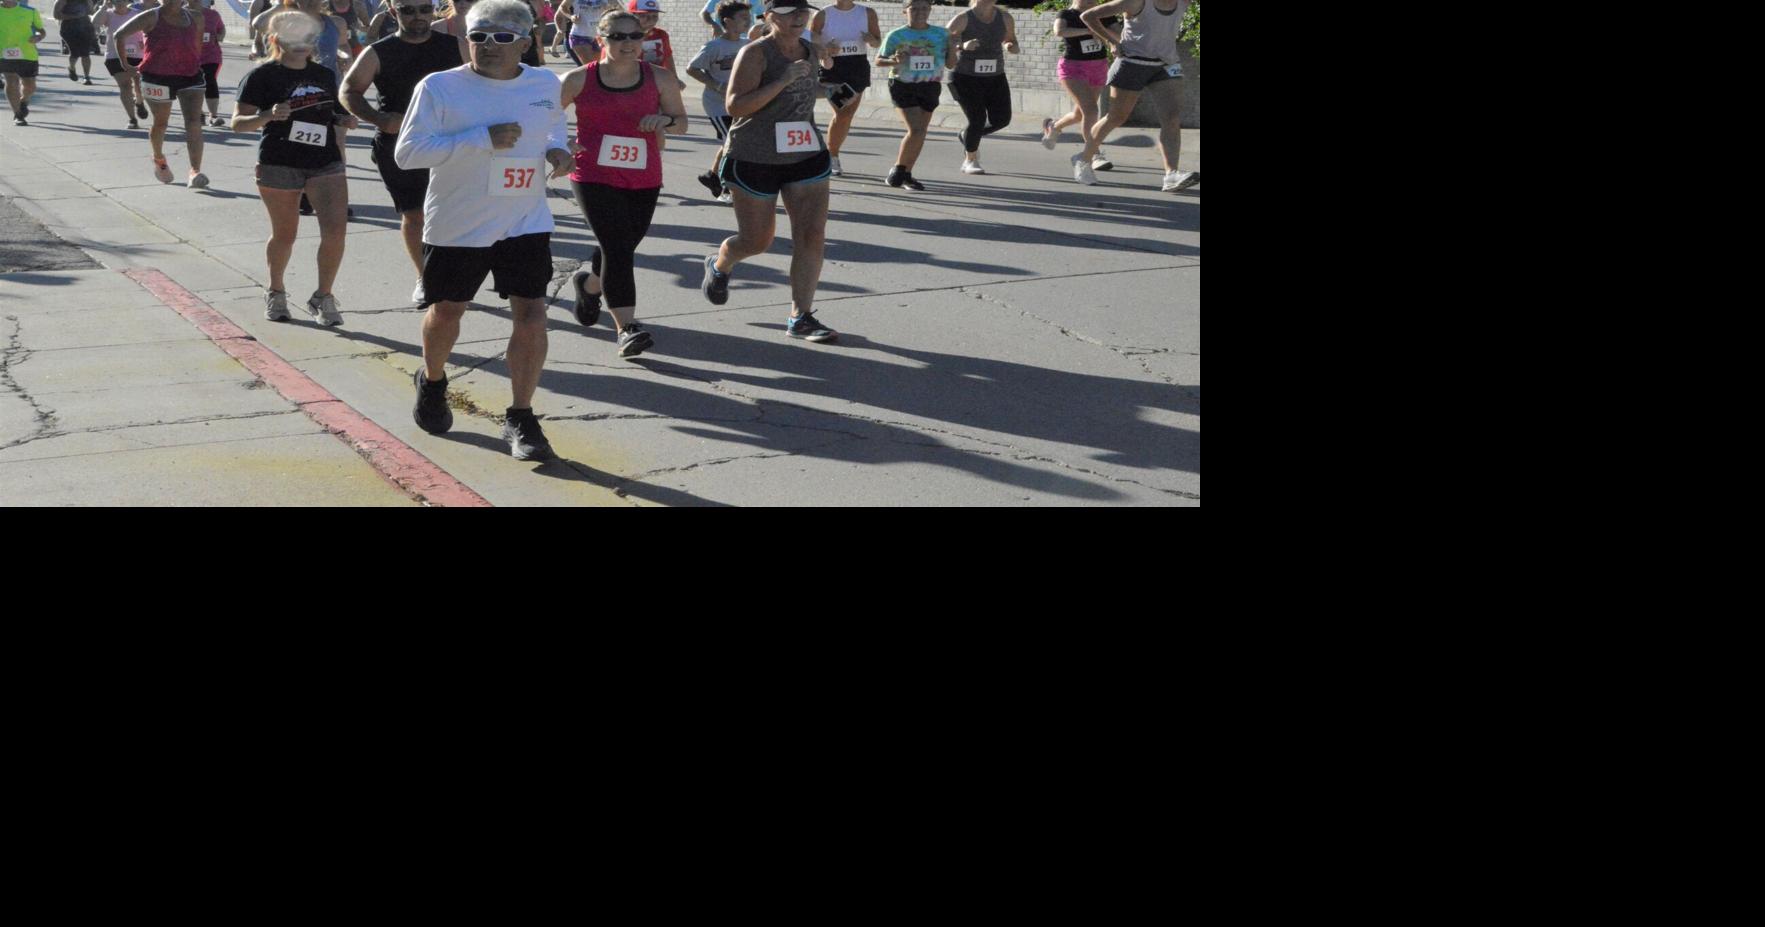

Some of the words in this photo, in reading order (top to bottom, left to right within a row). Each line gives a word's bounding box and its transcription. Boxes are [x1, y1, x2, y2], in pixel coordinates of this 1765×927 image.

[1086, 44, 1100, 52] 172
[914, 62, 931, 70] 173
[145, 88, 163, 97] 530
[294, 130, 322, 144] 212
[787, 129, 812, 146] 534
[610, 144, 639, 162] 533
[503, 168, 536, 188] 537
